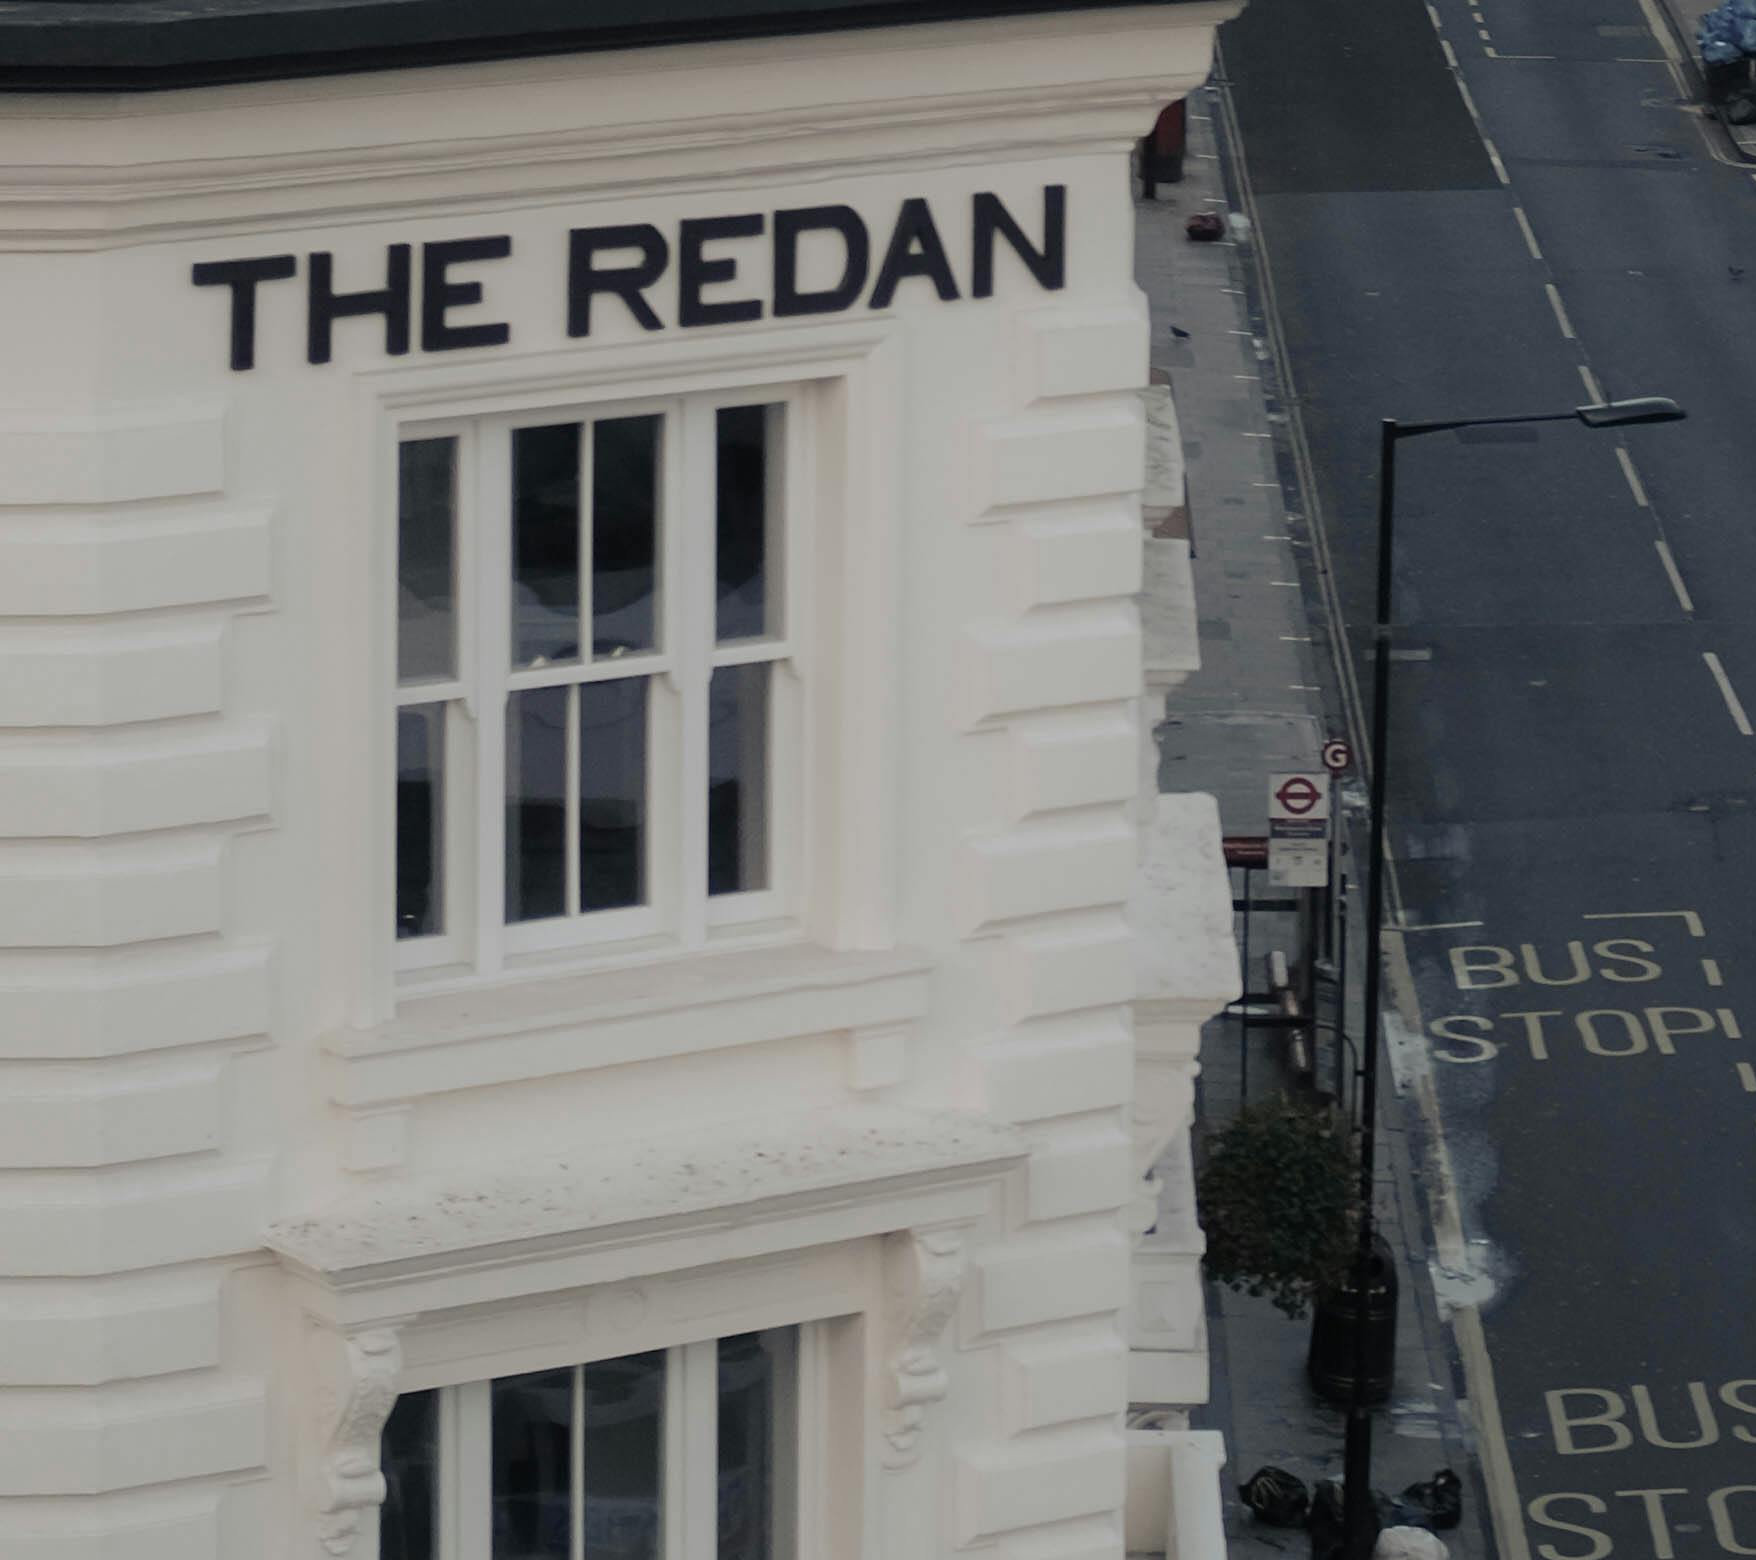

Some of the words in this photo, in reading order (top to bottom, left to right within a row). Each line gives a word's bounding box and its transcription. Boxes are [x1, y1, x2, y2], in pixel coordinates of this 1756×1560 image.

[192, 234, 513, 371] THE
[566, 183, 1067, 339] REDAN
[1324, 743, 1348, 769] G
[1448, 939, 1662, 990] BUS
[1430, 1008, 1718, 1064] STOP
